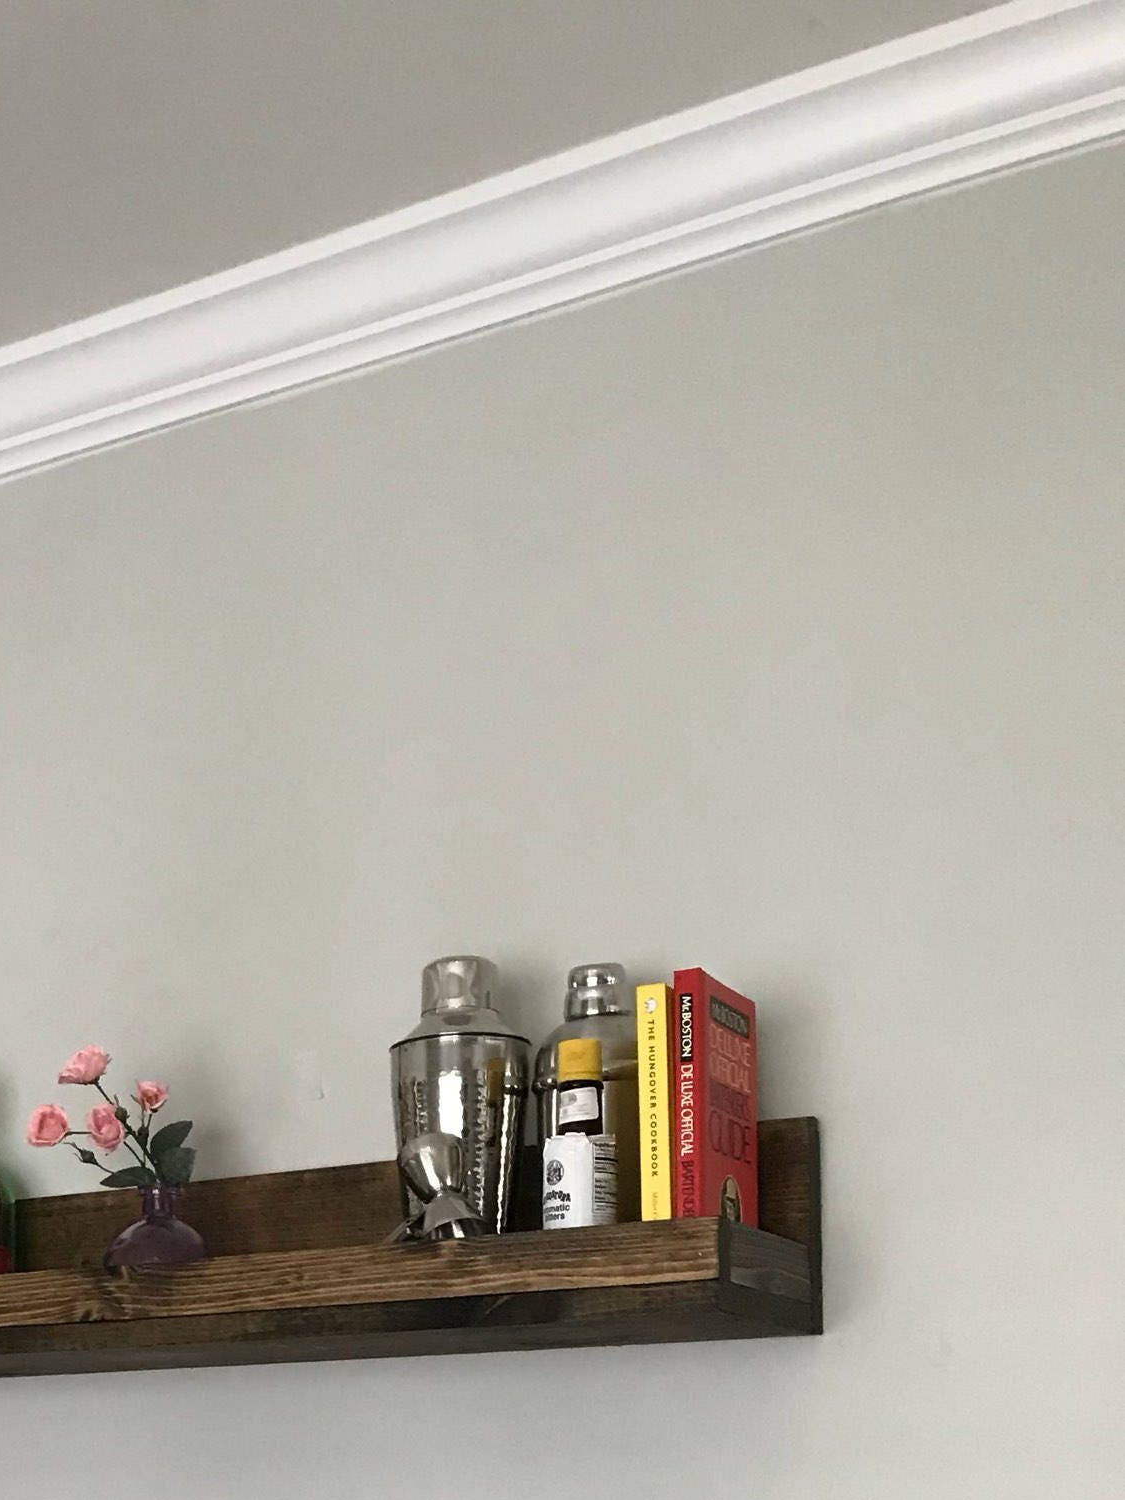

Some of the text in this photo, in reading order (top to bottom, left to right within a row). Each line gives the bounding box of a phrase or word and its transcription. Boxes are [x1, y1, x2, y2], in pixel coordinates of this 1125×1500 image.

[647, 1019, 659, 1177] THE HUNGOVER COOKBOOK
[680, 1108, 694, 1157] OFFICIAL
